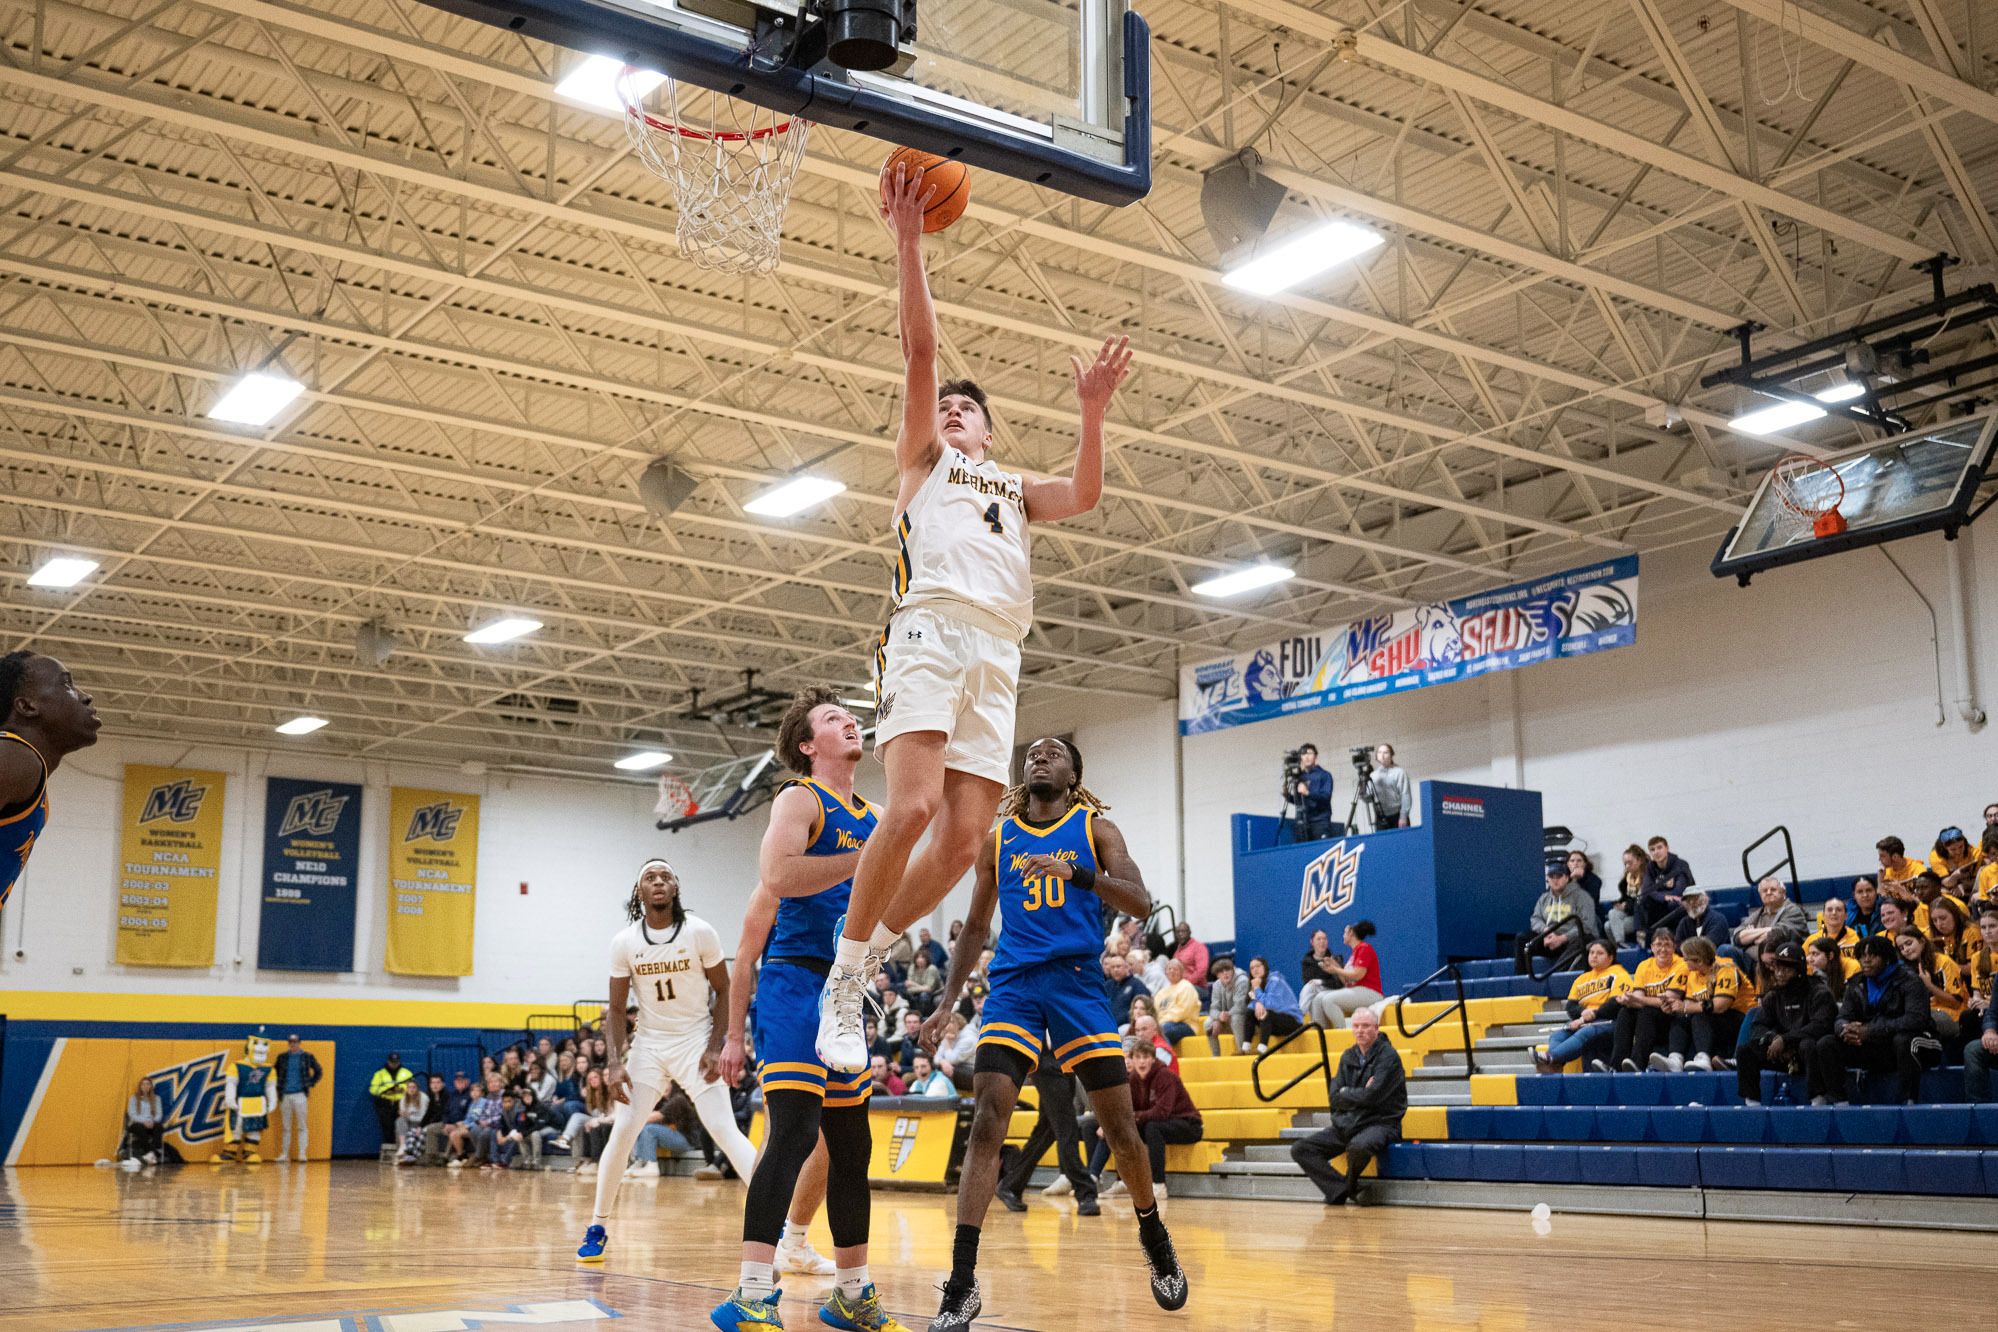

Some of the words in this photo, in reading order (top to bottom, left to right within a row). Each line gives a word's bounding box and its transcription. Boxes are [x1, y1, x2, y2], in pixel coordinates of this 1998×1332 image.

[983, 502, 1004, 534] 4
[1367, 621, 1422, 679] SHU
[137, 777, 212, 827] MC
[1442, 800, 1485, 813] CHANNEL
[278, 789, 350, 837] MC
[402, 800, 468, 845] MC
[153, 851, 189, 863] NCAA
[126, 863, 215, 878] TOURNAMENT
[273, 872, 348, 887] CHAMPIONS
[417, 869, 449, 879] NCAA
[394, 879, 472, 893] TOURNAMENT
[1022, 873, 1066, 911] 30
[1297, 839, 1365, 928] MC
[634, 958, 691, 976] MERRIMACK
[1677, 974, 1688, 986] 47
[1718, 978, 1732, 989] 47
[655, 978, 676, 1001] 11
